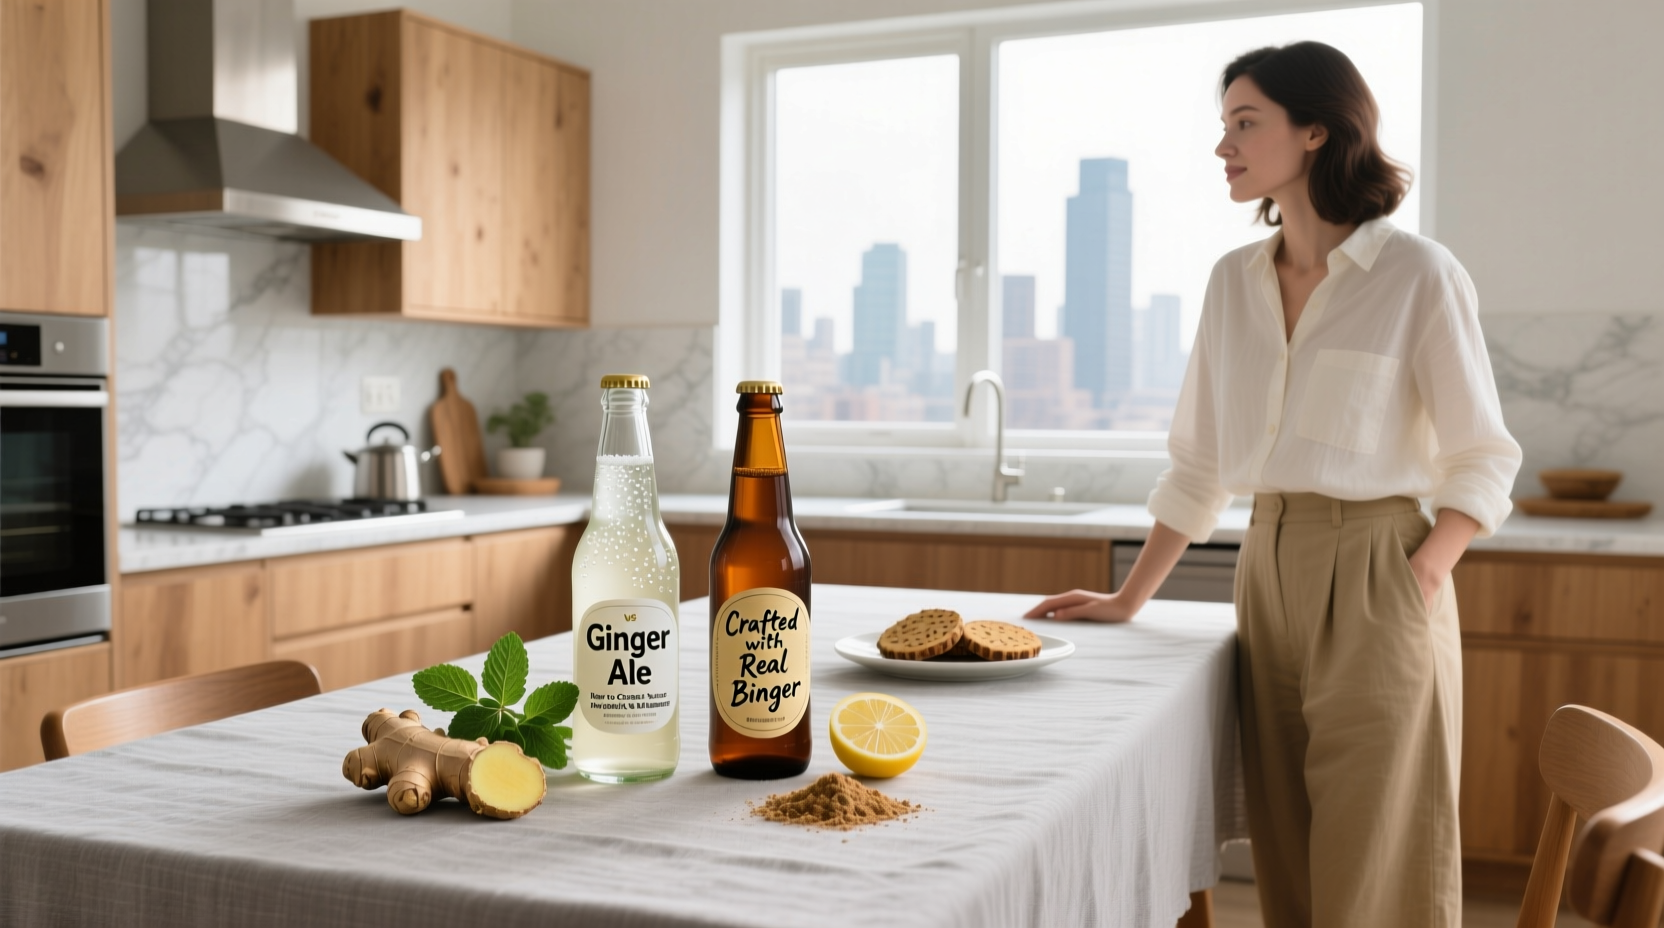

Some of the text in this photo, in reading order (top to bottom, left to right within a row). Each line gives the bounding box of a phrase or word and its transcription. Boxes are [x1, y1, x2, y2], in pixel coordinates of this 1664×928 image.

[725, 607, 800, 637] Crafted
[586, 623, 670, 659] Ginger
[745, 631, 783, 651] with
[607, 658, 652, 686] Ale
[739, 648, 789, 679] Real
[730, 679, 801, 713] Binger
